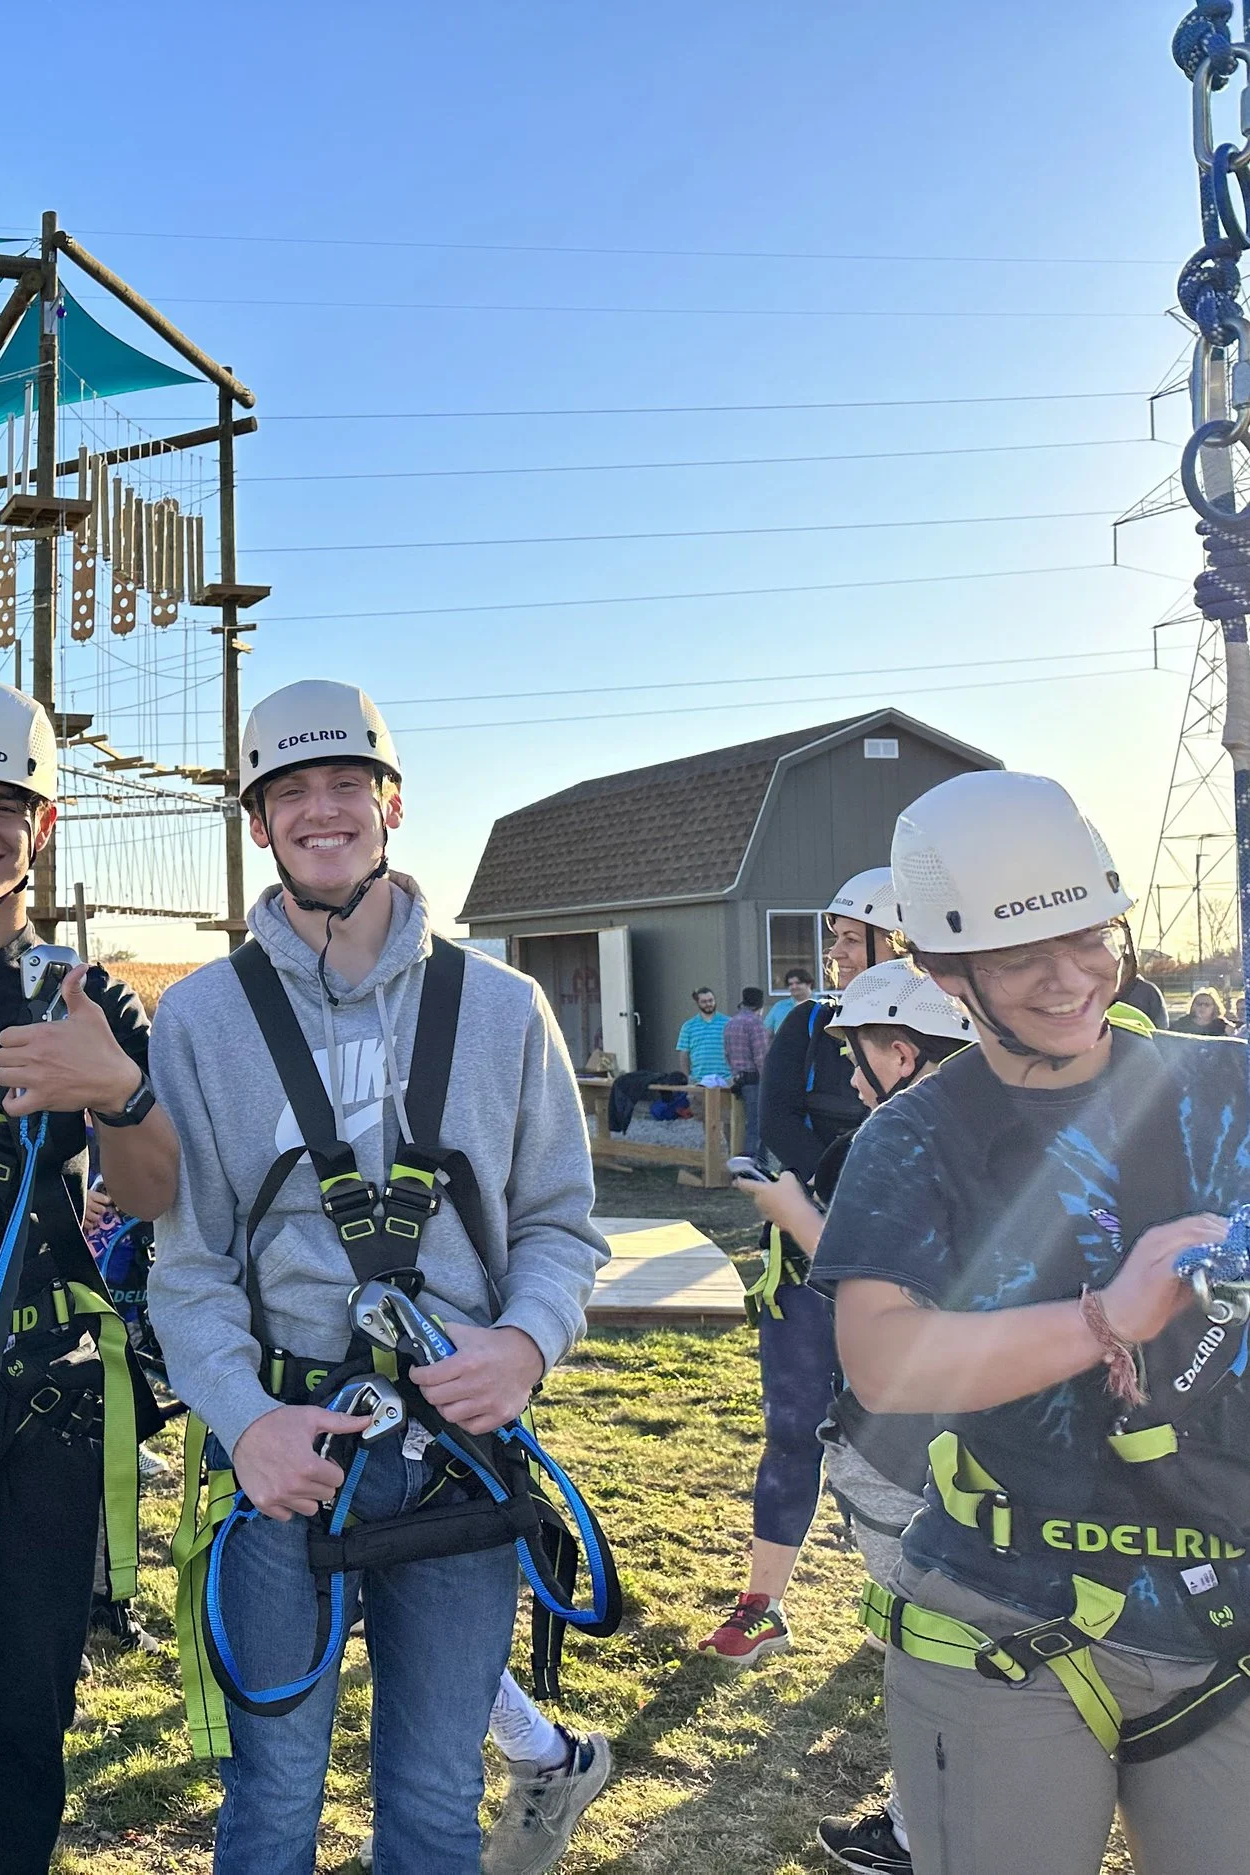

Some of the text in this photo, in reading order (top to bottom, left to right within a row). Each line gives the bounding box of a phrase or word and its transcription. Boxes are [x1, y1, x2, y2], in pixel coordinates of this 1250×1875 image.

[277, 730, 348, 750] EDELRID
[993, 886, 1088, 919] EDELRID
[421, 1321, 449, 1360] ELRID
[1173, 1325, 1227, 1392] EDELRID
